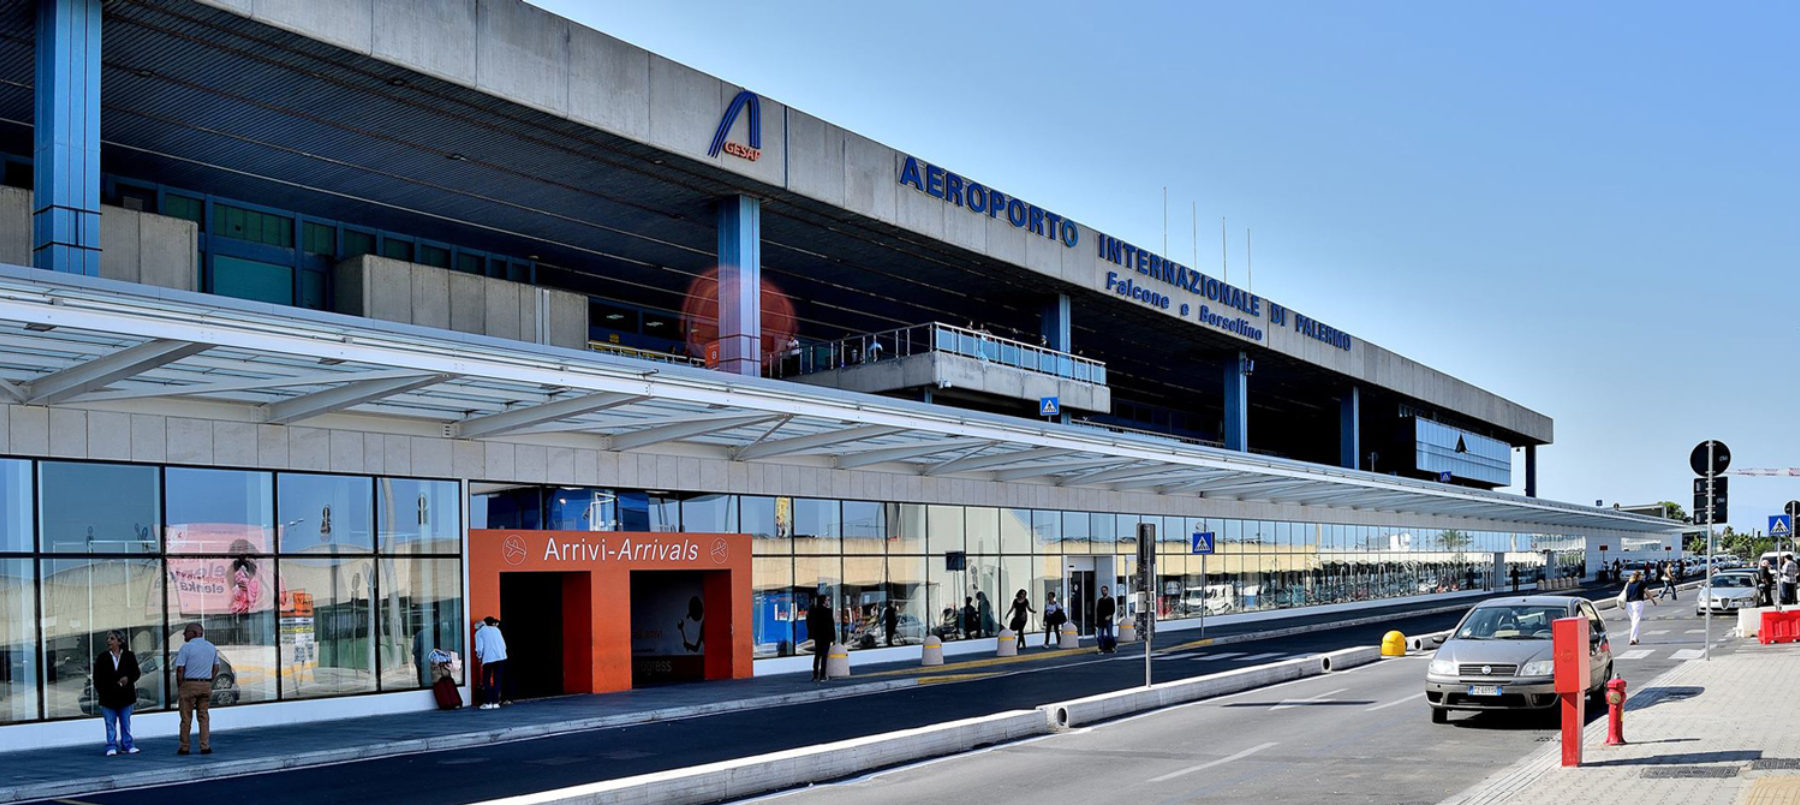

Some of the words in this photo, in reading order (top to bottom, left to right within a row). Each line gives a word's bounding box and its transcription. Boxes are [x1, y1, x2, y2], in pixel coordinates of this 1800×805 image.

[723, 140, 762, 161] GESAP
[900, 156, 1079, 248] AEROPORTO
[1099, 233, 1260, 317] INTERNAZIONALE
[1270, 303, 1286, 327] DI
[1295, 314, 1351, 351] PALERMO
[1106, 271, 1170, 309] Falcone
[1180, 303, 1190, 317] e
[1199, 304, 1262, 341] Borsellino
[544, 538, 698, 561] Arrivi-Arrivals
